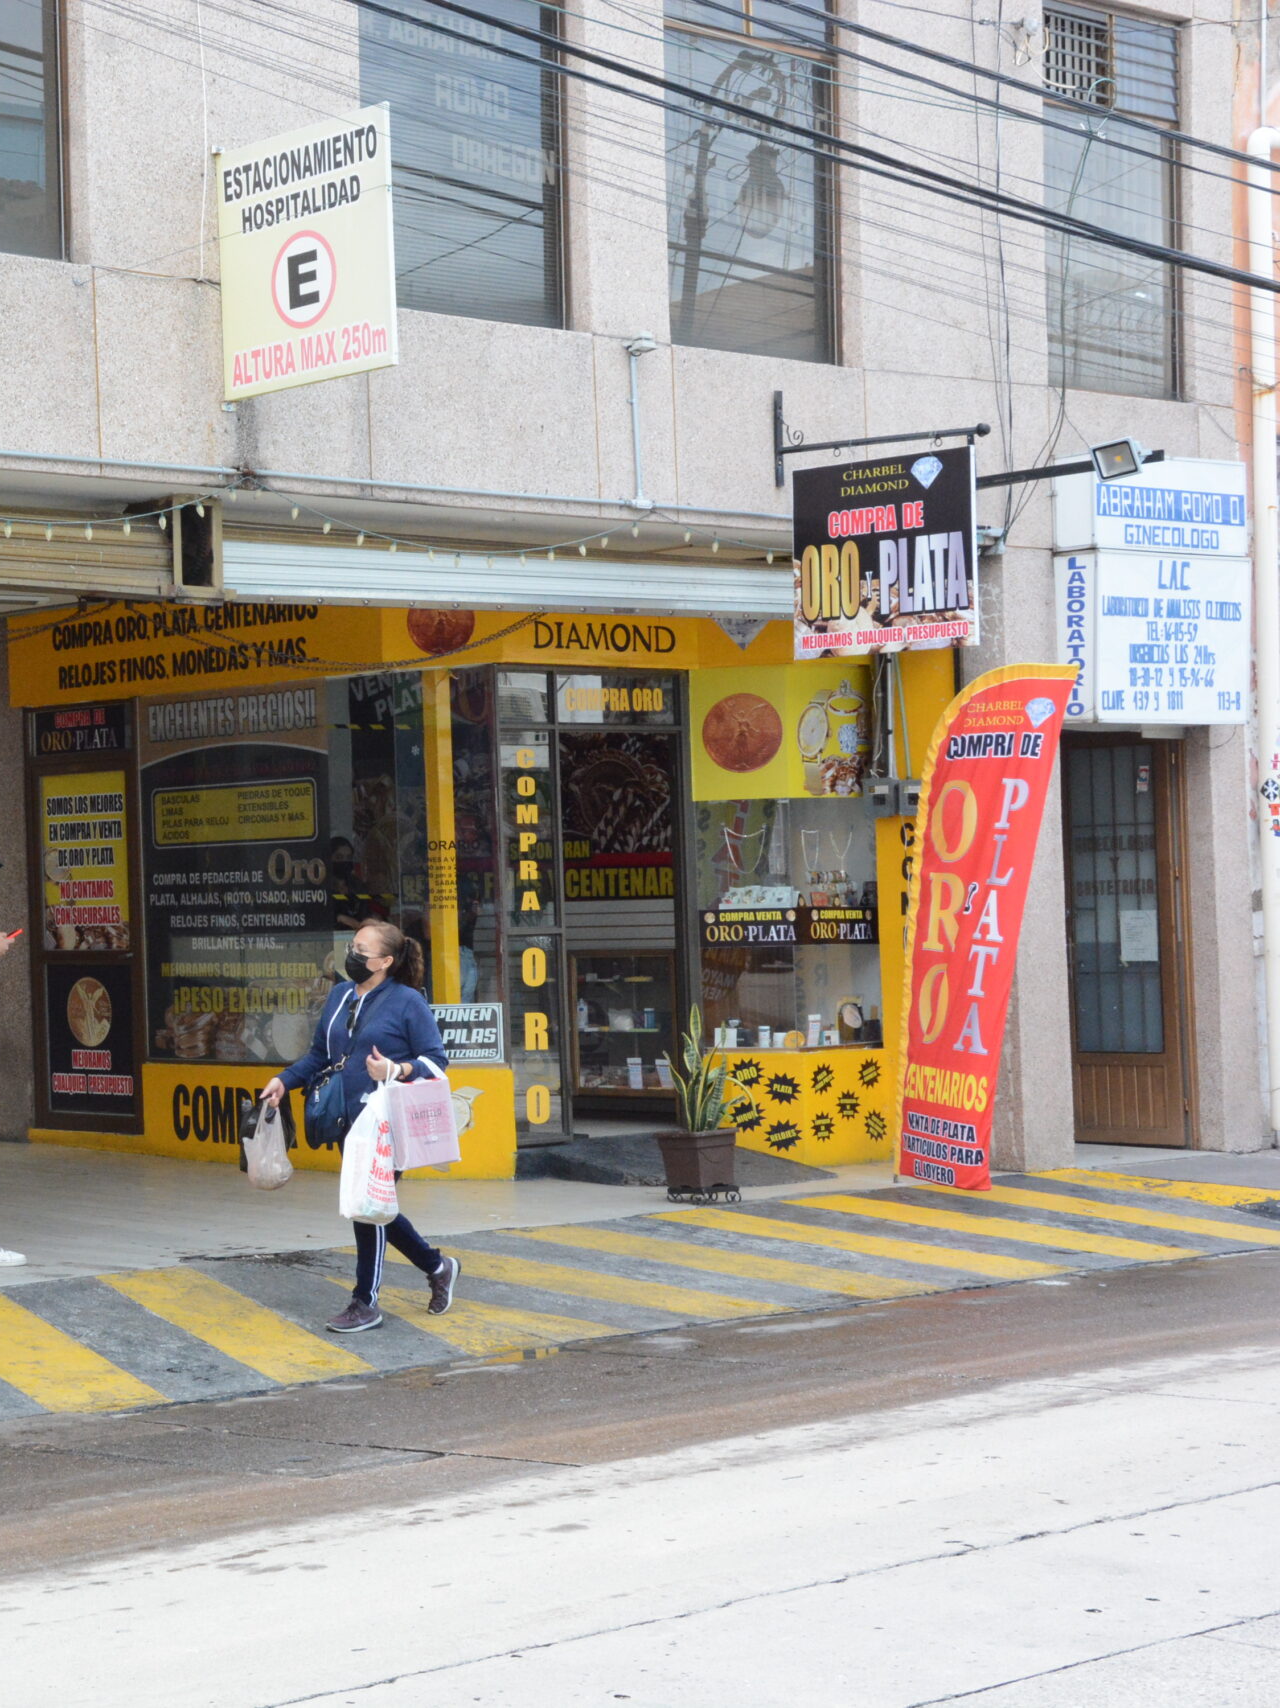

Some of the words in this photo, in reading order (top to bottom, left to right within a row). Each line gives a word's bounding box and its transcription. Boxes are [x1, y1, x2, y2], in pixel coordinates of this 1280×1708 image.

[435, 74, 509, 119] ROMO
[223, 124, 377, 202] ESTACIONAMIENTO
[242, 175, 360, 234] HOSPITALIDAD
[287, 249, 320, 310] E
[233, 344, 296, 387] ALTURA
[300, 330, 337, 370] MAX
[341, 322, 387, 363] 250m
[842, 463, 906, 482] CHARBEL
[841, 479, 909, 497] DIAMOND
[1099, 486, 1174, 519] ABRAHAM
[1181, 492, 1222, 523] ROMO
[828, 504, 897, 538] COMPRA
[902, 501, 924, 530] DE
[1124, 524, 1219, 549] GINECOLOGO
[801, 540, 860, 622] ORO
[879, 531, 969, 615] PLATA
[52, 620, 113, 651] COMPRA
[116, 614, 150, 643] ORO,
[204, 603, 318, 632] CENTENARIOS
[533, 620, 676, 653] DIAMOND
[802, 633, 853, 649] MEJORAMOS
[856, 628, 903, 646] CUALQUIER
[906, 621, 969, 641] PRESUPUESTO
[1066, 557, 1086, 717] LABORATORIO
[59, 660, 117, 689] RELOJES
[172, 645, 249, 677] MONEDAS
[247, 641, 262, 668] Y
[565, 688, 630, 712] COMPRA
[632, 688, 663, 712] ORO
[967, 700, 1024, 714] CHARBEL
[148, 696, 236, 743] EXCELENTES
[40, 730, 72, 752] ORO
[76, 728, 118, 750] PLATA
[1019, 732, 1044, 759] DE
[283, 786, 311, 797] TOQUE
[47, 797, 73, 816] SOMOS
[74, 796, 88, 814] LOS
[89, 794, 123, 813] MEJORES
[49, 823, 58, 842] EN
[59, 821, 91, 841] COMPRA
[98, 819, 122, 839] VENTA
[516, 749, 540, 911] COMPRA
[58, 848, 68, 867] DE
[68, 848, 85, 866] ORO
[91, 846, 114, 866] PLATA
[153, 873, 187, 885] COMPRA
[189, 872, 200, 884] DE
[202, 869, 249, 883] PEDACERÍA
[252, 870, 263, 883] DE
[268, 848, 326, 885] Oro
[60, 881, 71, 899] NO
[72, 879, 114, 899] CONTAMOS
[256, 890, 290, 905] USADO,
[292, 889, 328, 906] NUEVO)
[56, 907, 71, 927] CON
[72, 905, 120, 926] SUCURSALES
[170, 915, 208, 928] RELOJES
[210, 914, 240, 929] FINOS,
[241, 913, 306, 927] CENTENARIOS
[720, 912, 754, 922] COMPRA
[755, 911, 782, 921] VENTA
[820, 910, 844, 919] COMPRA
[845, 910, 863, 919] VENTA
[952, 778, 1029, 1055] PLATA
[706, 924, 743, 942] ORO
[747, 925, 797, 942] PLATA
[810, 921, 837, 940] ORO
[840, 922, 873, 940] PLATA
[192, 937, 245, 950] BRILLANTES
[247, 936, 255, 949] Y
[161, 962, 220, 977] MEJORAMOS
[434, 1008, 492, 1022] PONEN
[442, 1028, 497, 1044] PILAS
[522, 947, 551, 1125] ORO
[72, 1049, 111, 1069] MEJORAMOS
[52, 1073, 86, 1095] CUALQUIER
[88, 1073, 133, 1096] PRESUPUESTO
[736, 1066, 758, 1081] ORO
[773, 1083, 793, 1094] PLATA
[930, 1118, 941, 1135] DE
[942, 1120, 977, 1144] PLATA
[908, 1136, 948, 1161] ARTICULOS
[949, 1145, 984, 1166] PARA
